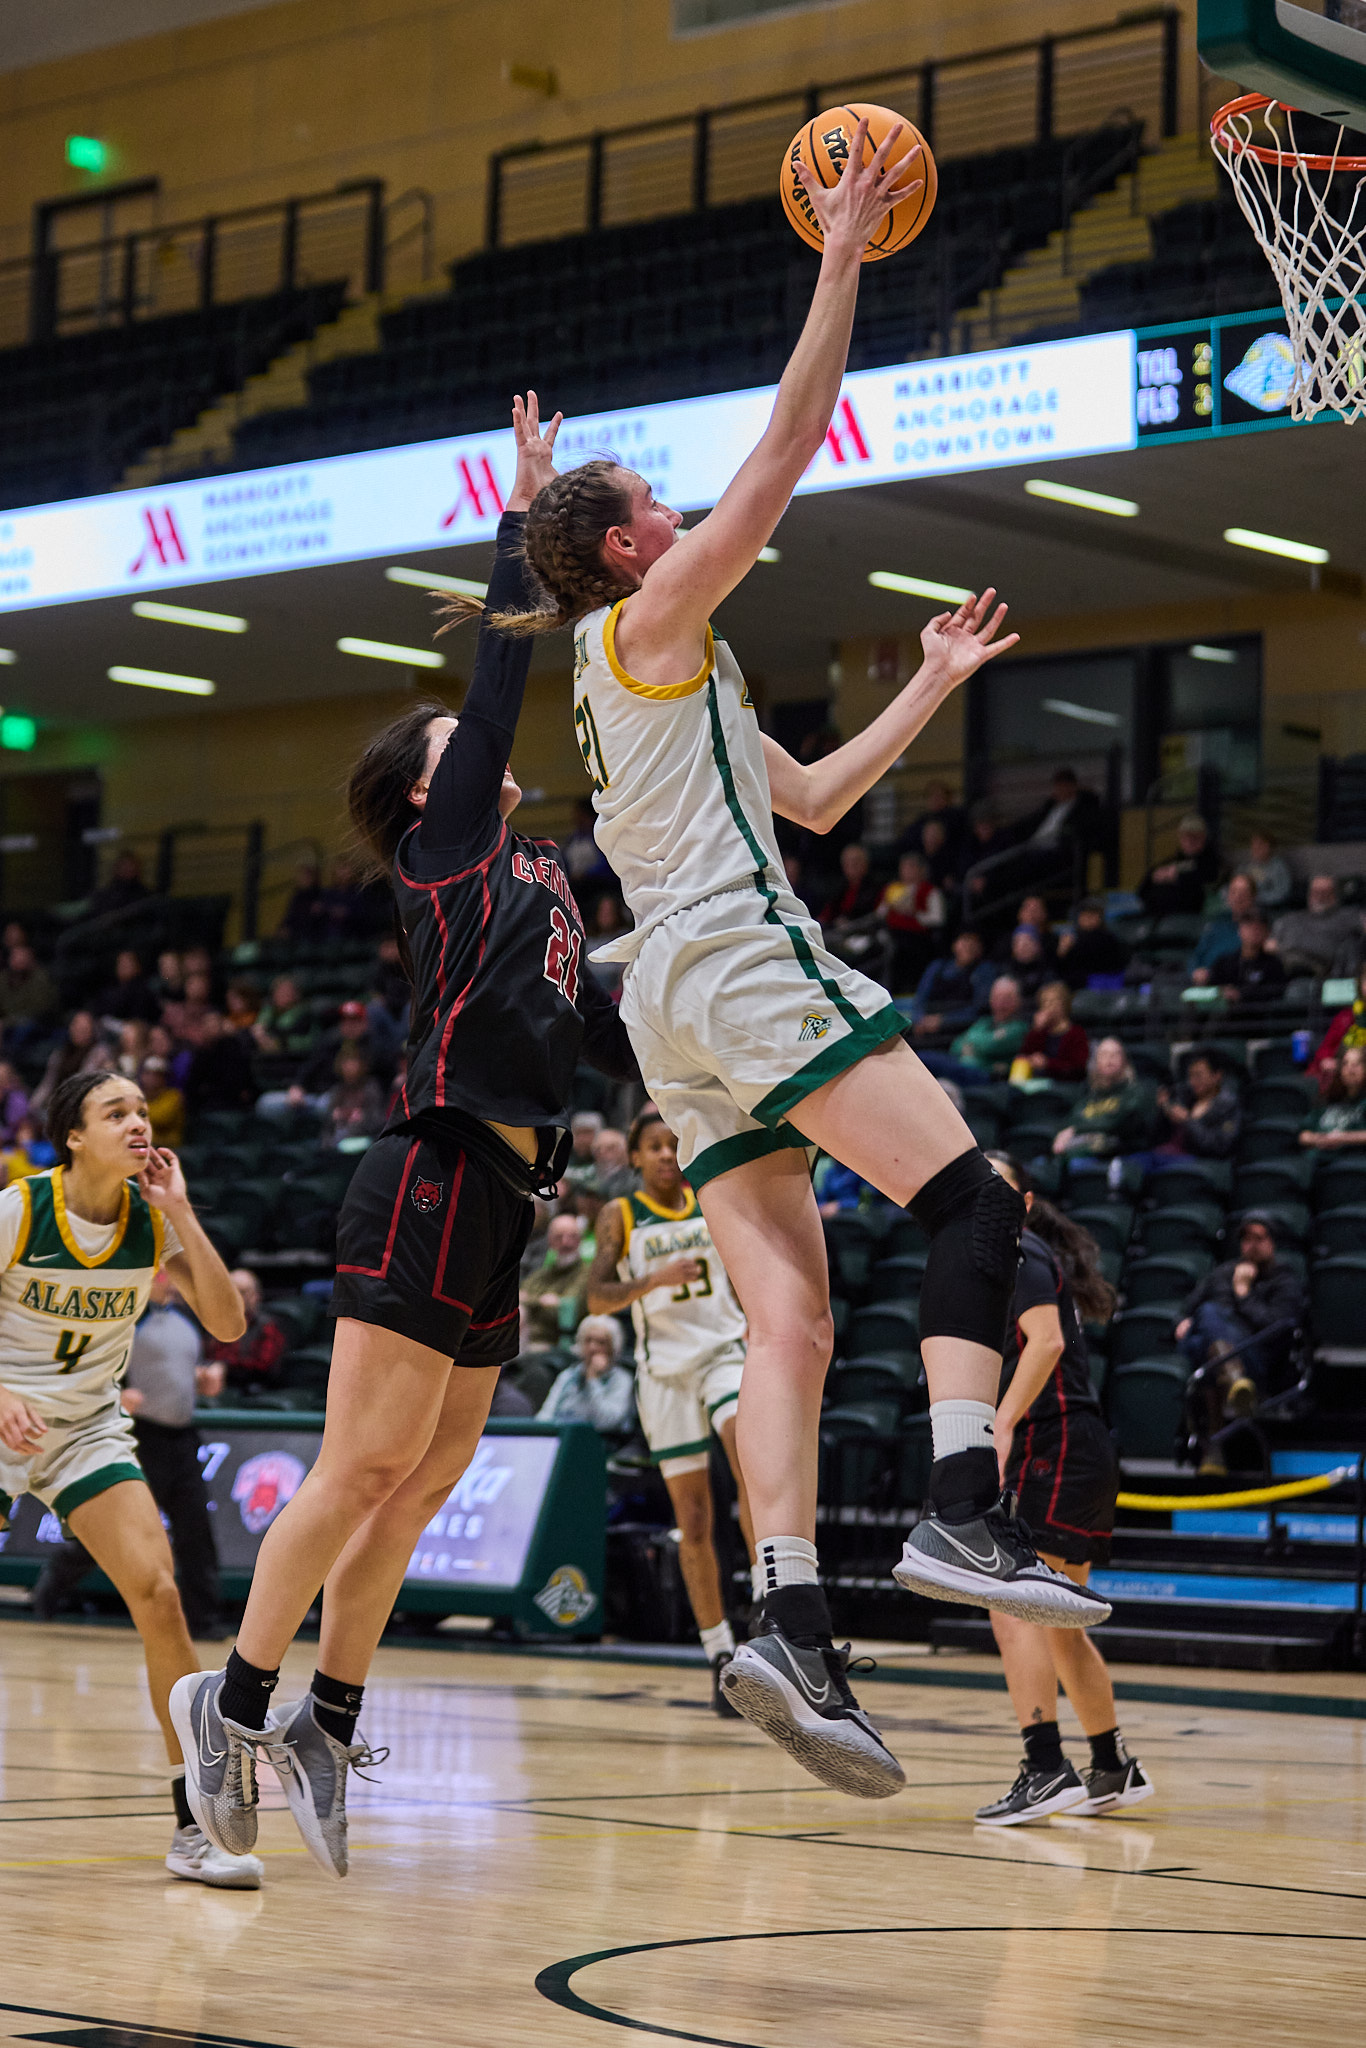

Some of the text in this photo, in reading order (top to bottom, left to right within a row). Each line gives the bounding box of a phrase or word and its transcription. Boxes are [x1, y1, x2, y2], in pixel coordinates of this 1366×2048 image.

[820, 125, 850, 178] CAA
[895, 359, 1031, 398] MARRIOTT
[895, 388, 1059, 431] ANCHORAGE
[894, 423, 1056, 464] DOWNTOWN
[543, 905, 582, 1009] 21
[19, 1277, 138, 1322] ALASKA
[53, 1329, 93, 1374] 4
